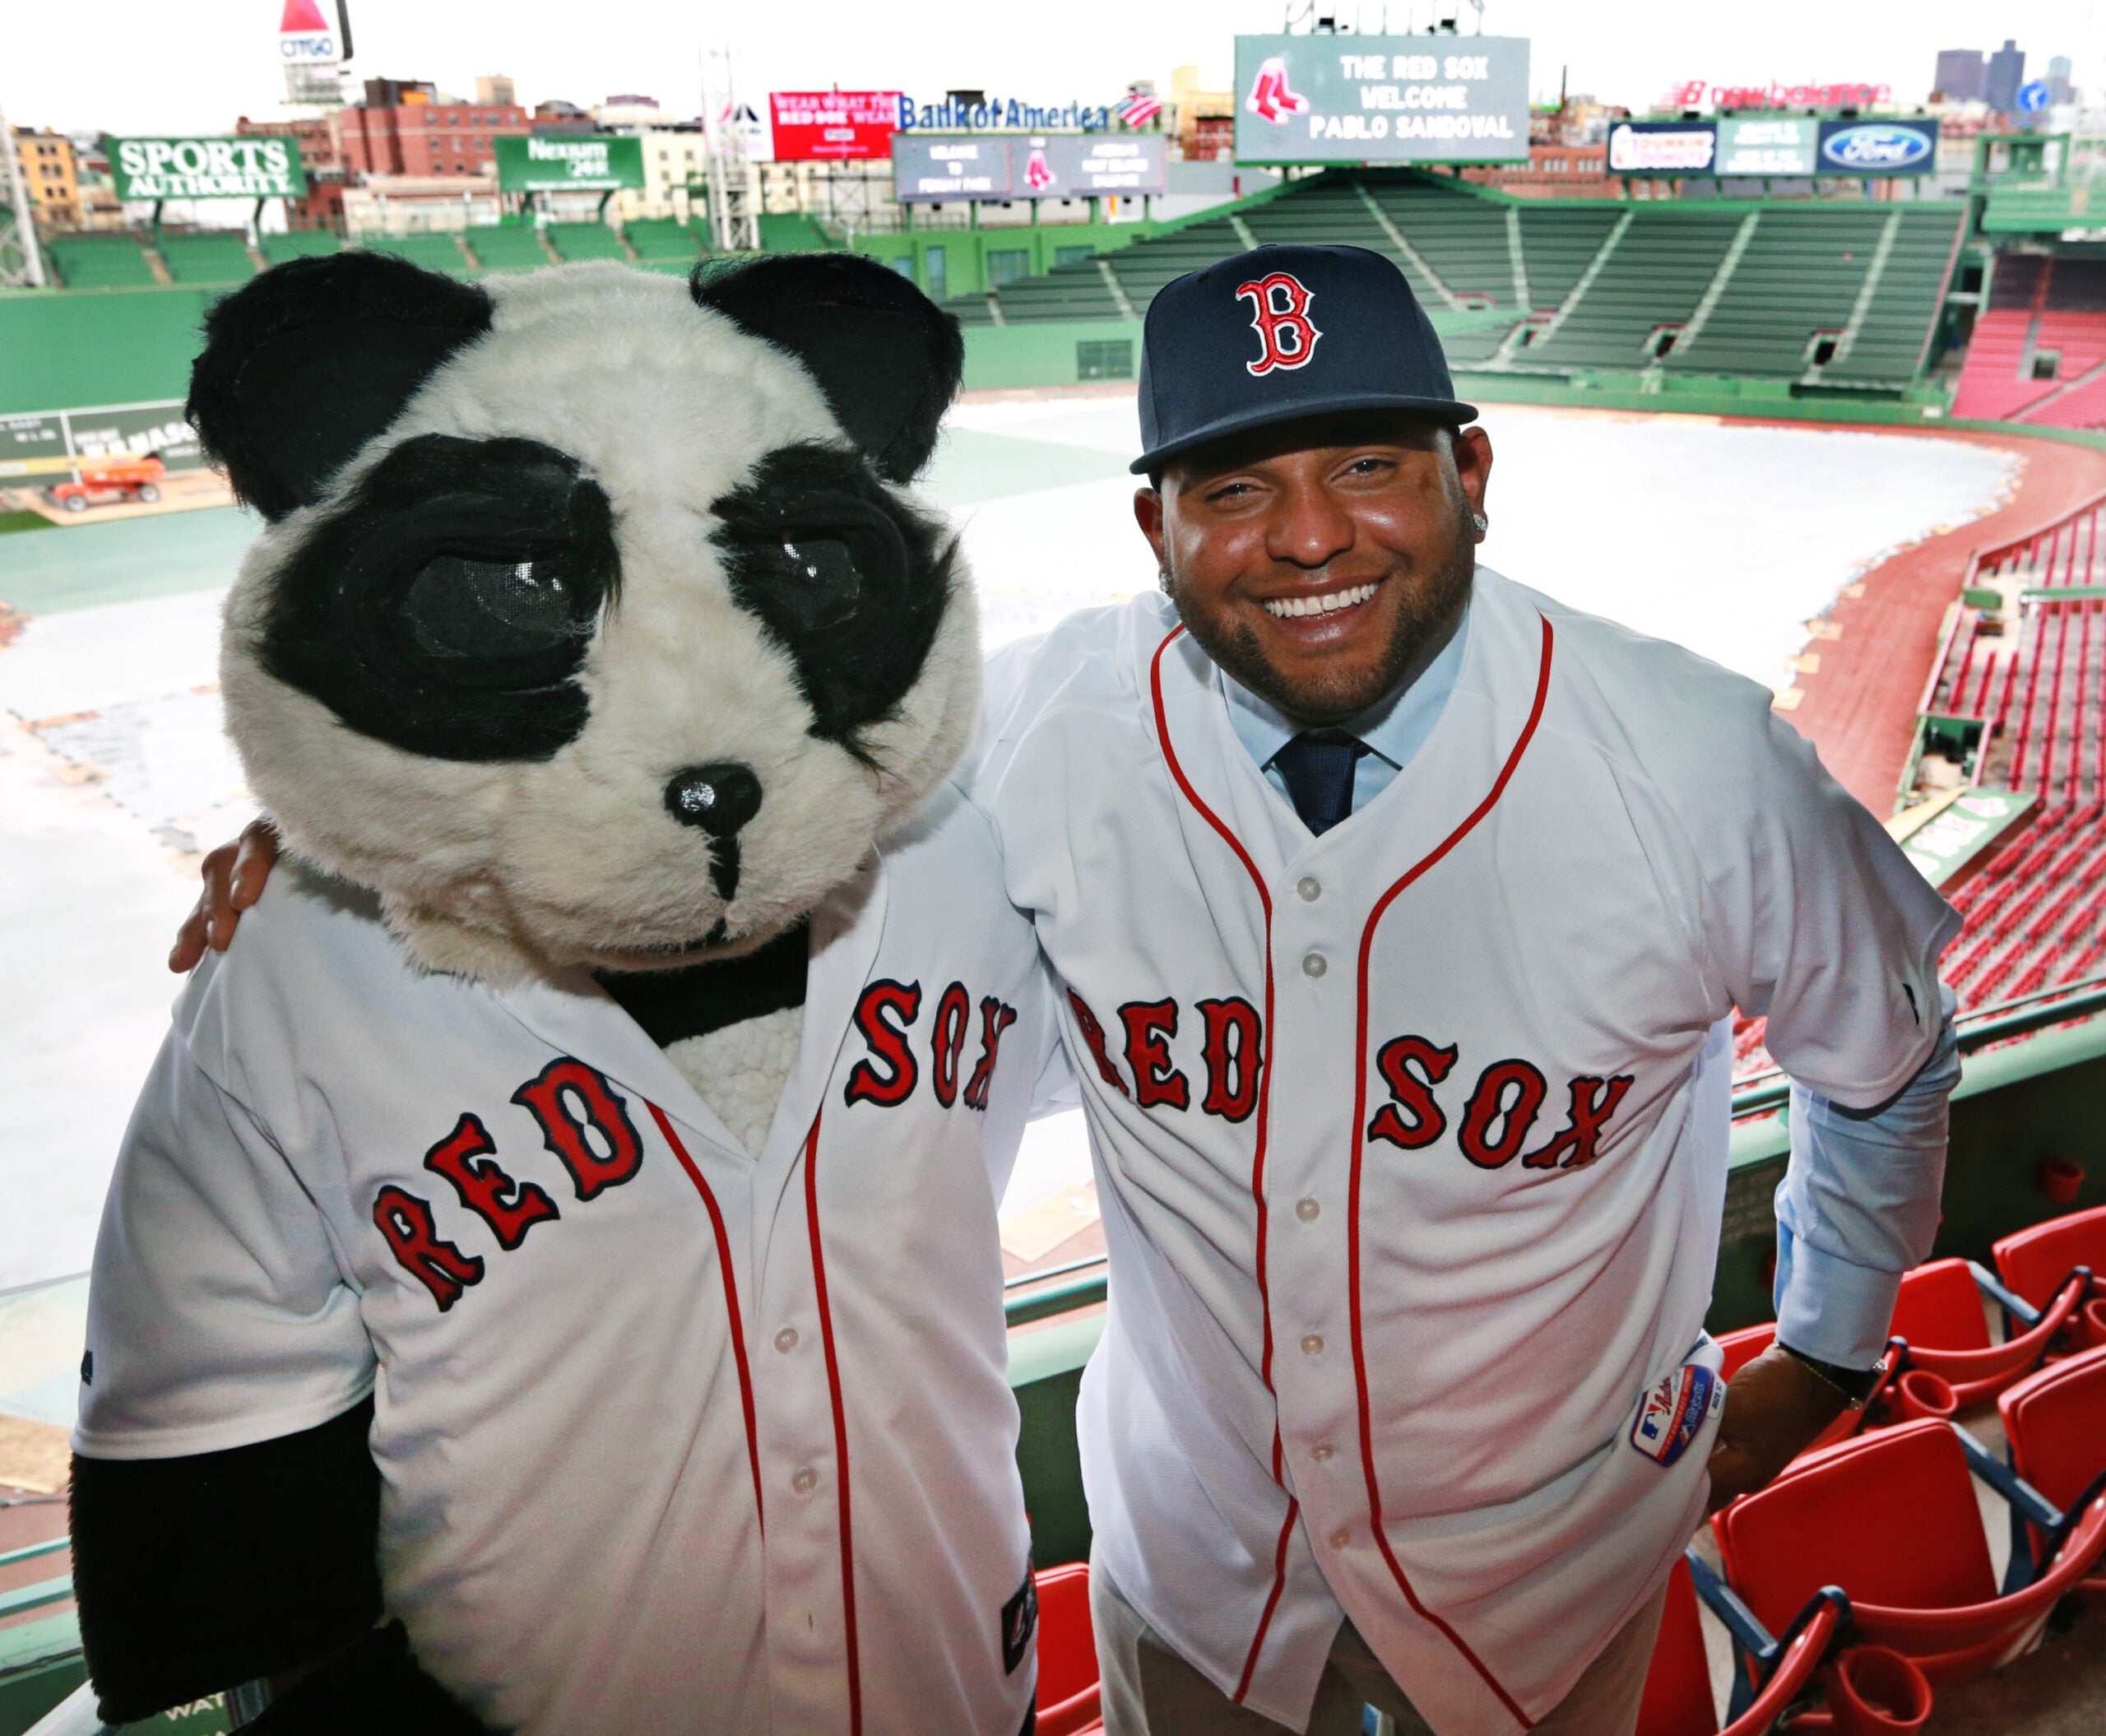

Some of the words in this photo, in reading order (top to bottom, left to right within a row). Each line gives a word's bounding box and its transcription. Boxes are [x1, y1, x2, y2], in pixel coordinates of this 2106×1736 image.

[1340, 55, 1386, 80] THE
[1393, 55, 1437, 80] RED
[1444, 56, 1489, 80] SOX
[898, 94, 970, 128] Bank
[974, 97, 1000, 128] of
[1005, 97, 1108, 129] America
[1360, 86, 1468, 109] WELCOME
[1309, 115, 1389, 139] PABLO
[1395, 115, 1515, 139] SANDOVAL
[118, 139, 290, 176] SPORTS
[1842, 131, 1910, 161] Ford
[128, 174, 291, 197] AUTHORITY
[1236, 272, 1324, 377] B
[1367, 1034, 1635, 1169] SOX
[373, 1056, 644, 1313] RED
[843, 978, 1018, 1112] SOX
